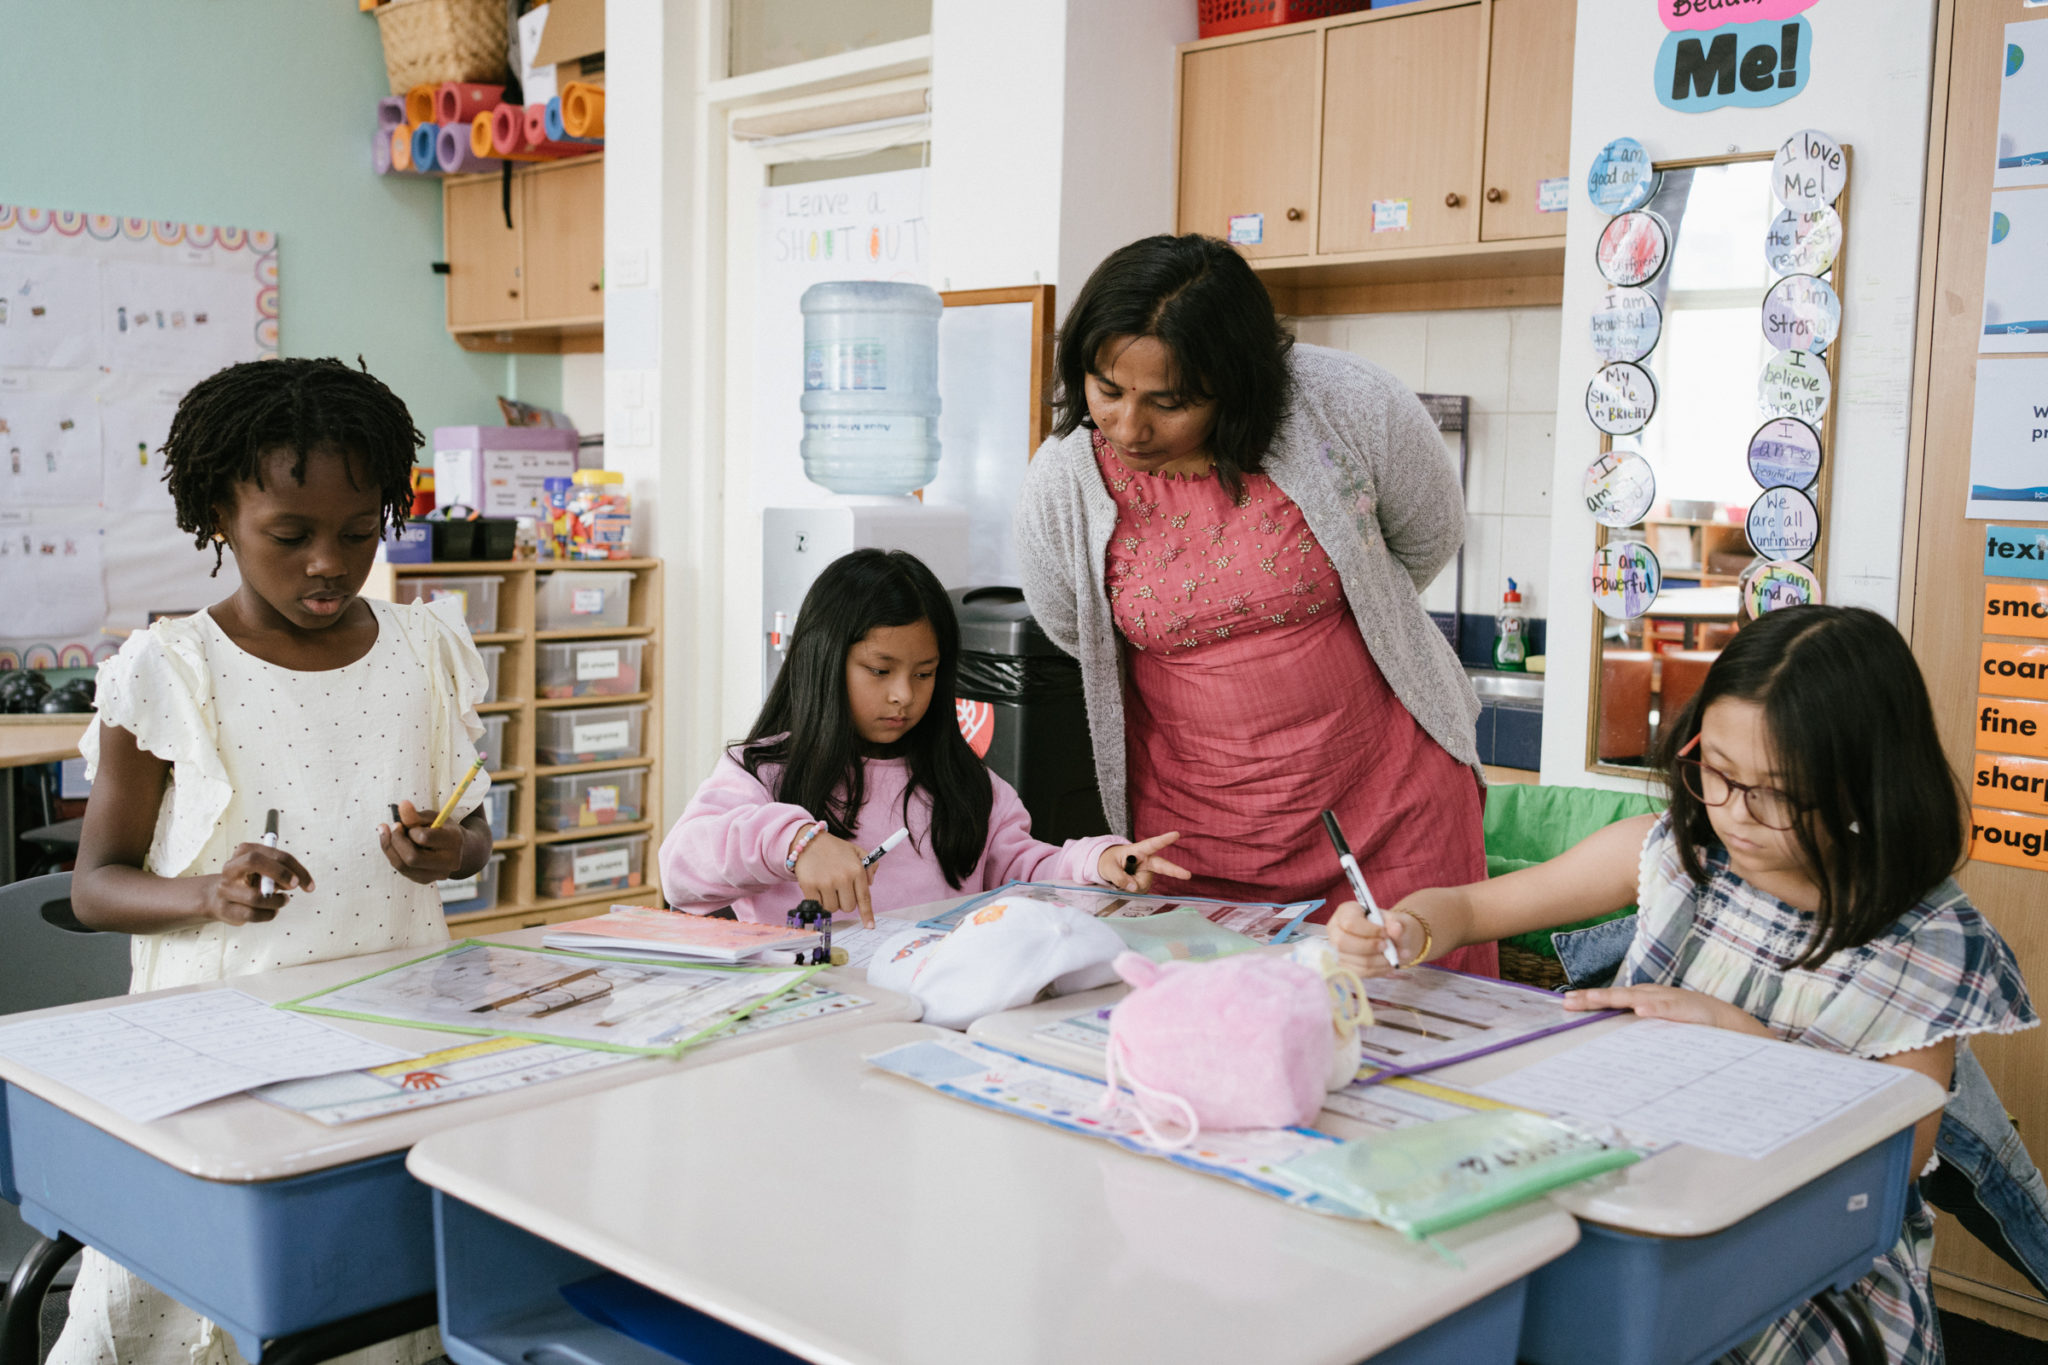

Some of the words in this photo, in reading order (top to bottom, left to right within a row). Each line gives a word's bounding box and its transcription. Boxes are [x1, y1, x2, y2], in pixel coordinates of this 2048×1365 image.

[1672, 23, 1800, 100] Me!
[1603, 146, 1615, 163] I
[1621, 148, 1643, 162] am
[1780, 137, 1797, 166] I
[1805, 132, 1840, 170] love
[1590, 166, 1617, 193] good
[1622, 167, 1638, 184] at
[1784, 165, 1825, 201] Me!
[786, 191, 849, 217] Leave
[867, 192, 886, 214] a
[776, 226, 856, 262] SHOUT
[866, 217, 923, 263] OUT
[1767, 230, 1791, 246] the
[1605, 295, 1617, 310] I
[1623, 296, 1646, 310] am
[1801, 288, 1828, 305] am
[1789, 349, 1806, 368] I
[1606, 367, 1629, 386] My
[1764, 362, 1820, 391] believe
[1779, 387, 1792, 401] in
[1778, 422, 1794, 438] I
[1760, 441, 1794, 459] am
[1593, 454, 1618, 479] I
[1586, 488, 1612, 512] am
[1767, 493, 1790, 509] We
[1752, 515, 1775, 527] are
[1784, 510, 1802, 527] all
[1757, 530, 1812, 547] unfinished
[1599, 549, 1612, 566] I
[1618, 554, 1645, 570] am
[1764, 564, 1781, 581] I
[1786, 573, 1810, 590] am
[1980, 707, 2037, 736] fine
